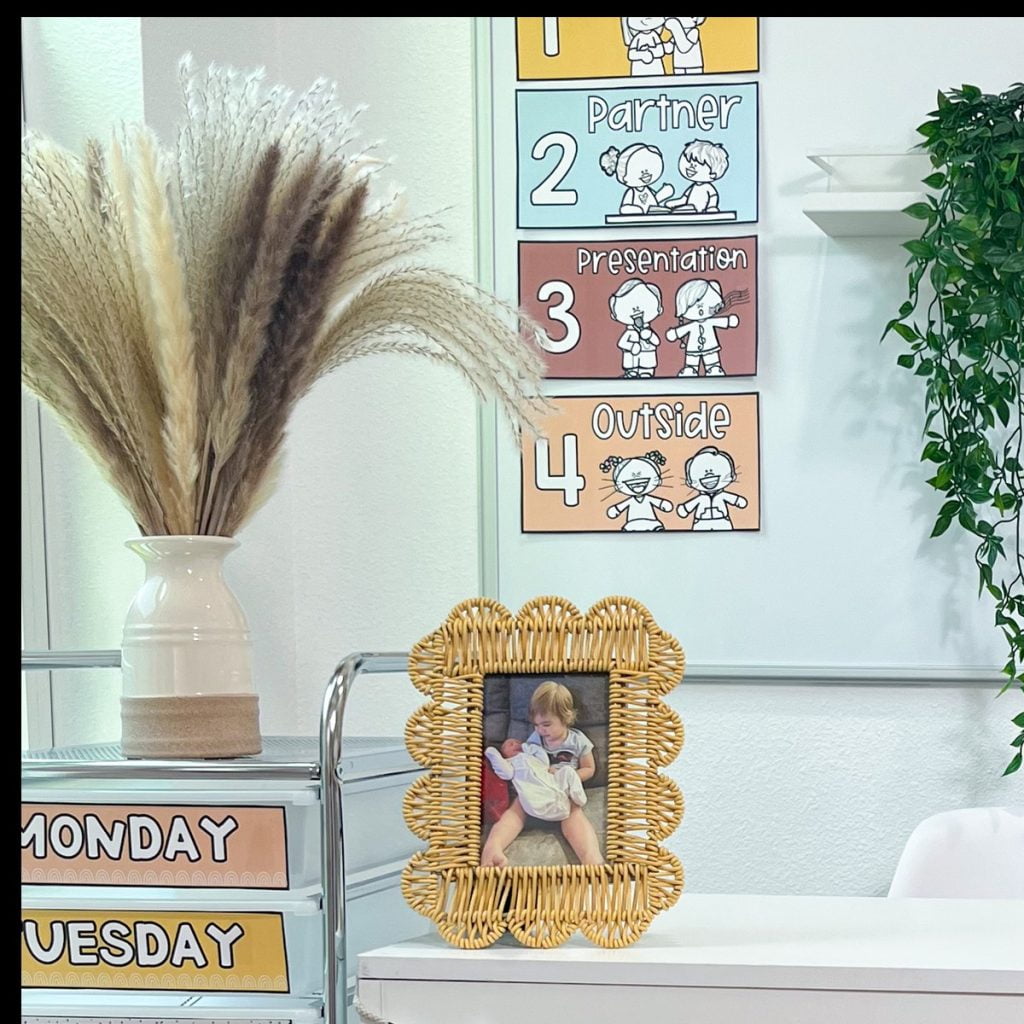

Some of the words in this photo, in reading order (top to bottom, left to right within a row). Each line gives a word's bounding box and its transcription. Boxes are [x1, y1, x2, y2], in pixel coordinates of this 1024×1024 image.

[587, 95, 742, 134] Partner
[530, 131, 578, 206] 2
[576, 246, 748, 275] Presentation
[536, 280, 581, 353] 3
[591, 402, 731, 440] Outside
[535, 433, 586, 507] 4
[21, 813, 238, 862] MONDAY
[21, 919, 244, 969] UESDAY
